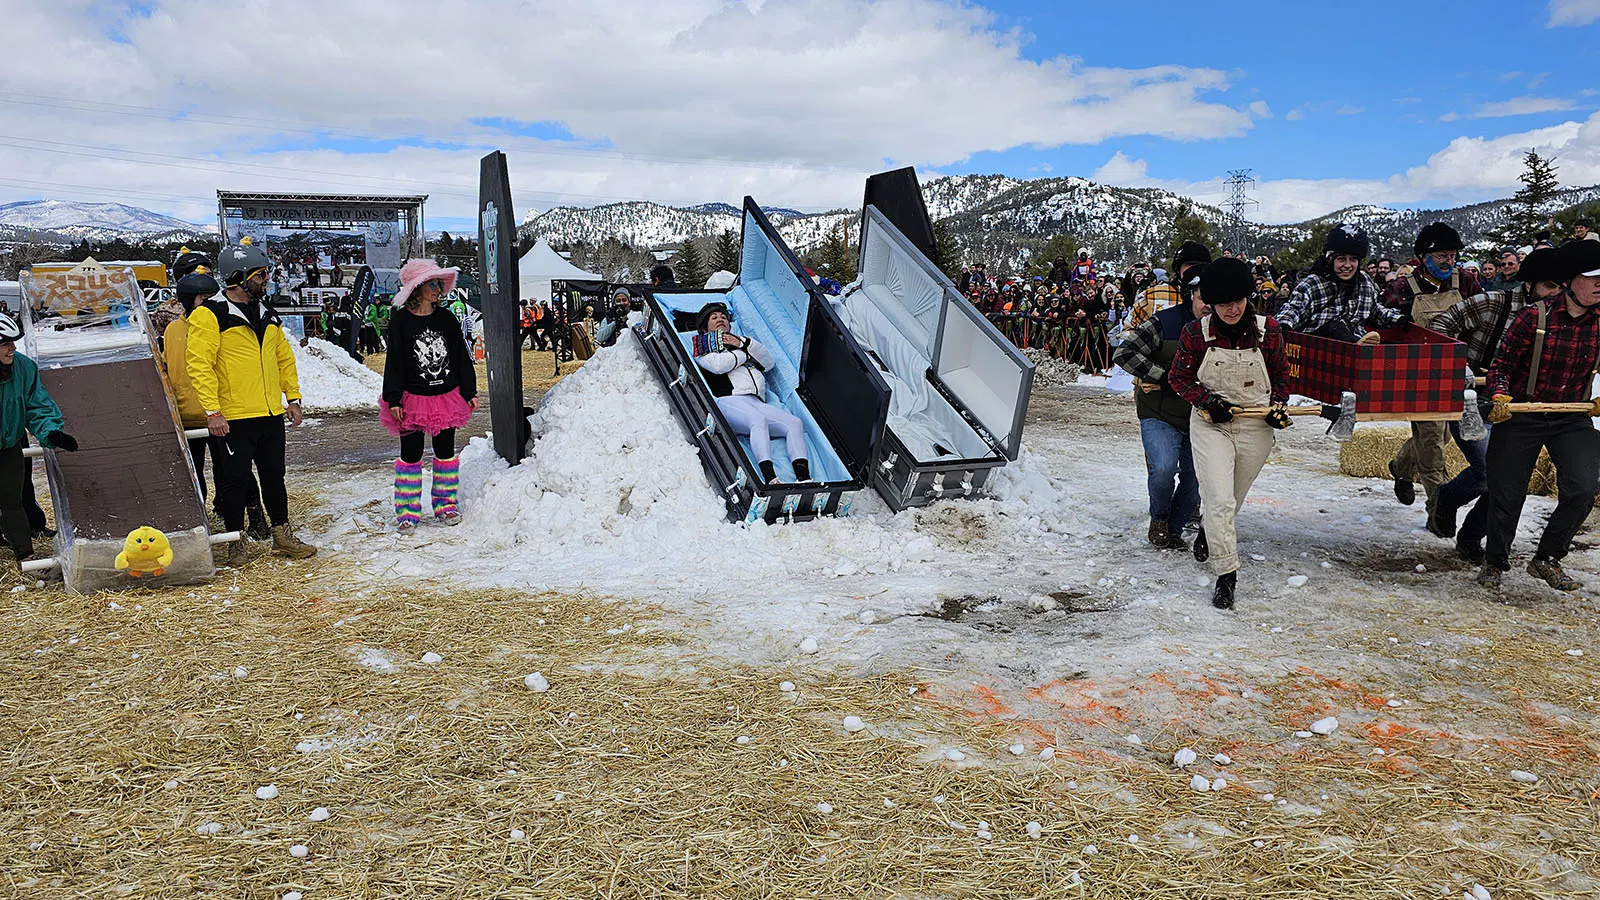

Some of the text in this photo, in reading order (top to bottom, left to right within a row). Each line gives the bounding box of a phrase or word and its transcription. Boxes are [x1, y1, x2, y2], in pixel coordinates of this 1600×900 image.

[263, 208, 380, 220] FROZEN DEAD GUY DAYS
[1285, 342, 1302, 359] ARTY
